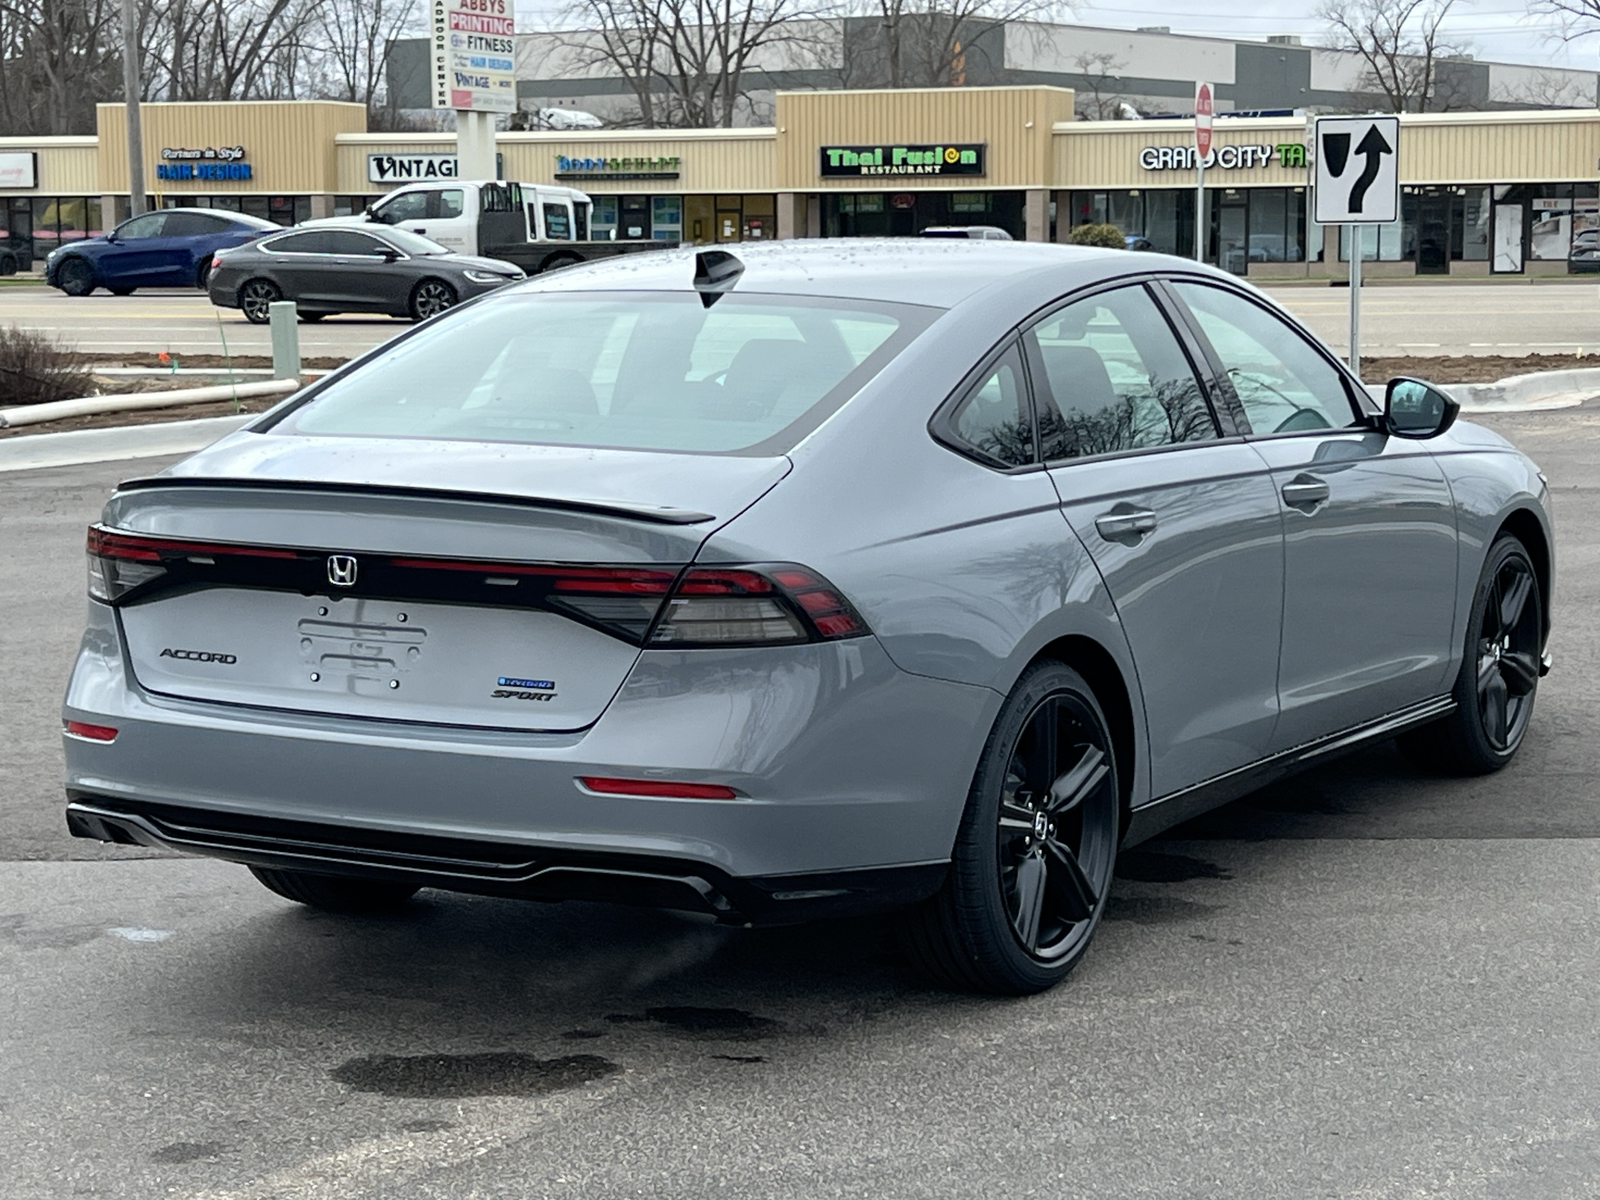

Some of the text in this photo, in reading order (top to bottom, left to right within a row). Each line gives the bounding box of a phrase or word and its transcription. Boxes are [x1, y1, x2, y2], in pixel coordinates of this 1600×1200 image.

[460, 0, 505, 14] ABBYS
[450, 13, 514, 35] PRINTING
[467, 35, 513, 53] FITNESS
[436, 56, 446, 106] CENTER
[454, 72, 490, 88] VINTAGE
[162, 146, 245, 161] Partners in Style
[827, 147, 977, 167] Thai Fusion
[1217, 145, 1272, 169] CITY
[1275, 143, 1307, 168] TA
[157, 163, 252, 180] HAIR DESIGN
[372, 156, 459, 180] VINTAG
[860, 165, 942, 175] RESTAURANT
[159, 648, 237, 664] ACCORD
[490, 689, 558, 701] SPORT
